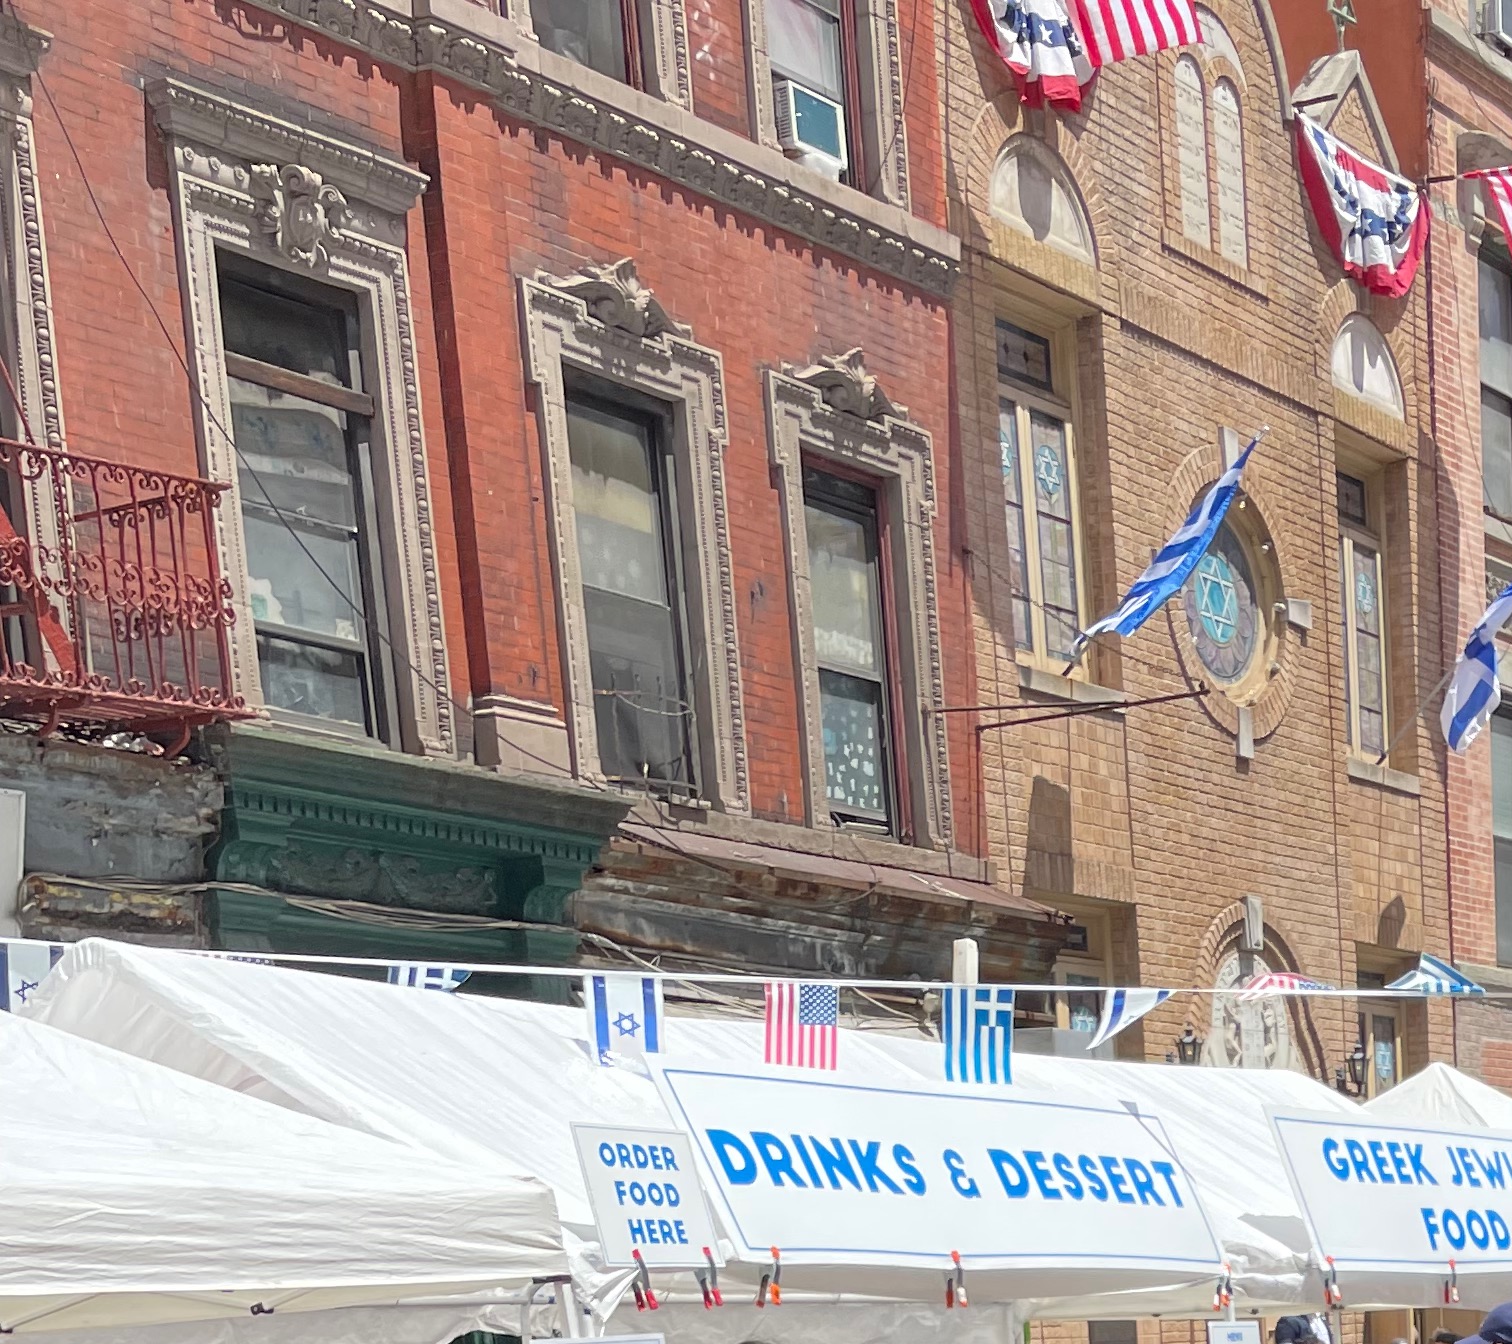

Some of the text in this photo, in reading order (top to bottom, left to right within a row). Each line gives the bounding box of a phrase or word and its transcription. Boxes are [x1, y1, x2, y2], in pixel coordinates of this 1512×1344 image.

[599, 1142, 680, 1172] ORDER
[705, 1129, 1186, 1208] DRINKS & DESSERT
[1322, 1138, 1439, 1186] GREEK
[617, 1181, 681, 1208] FOOD
[628, 1218, 689, 1245] HERE
[1421, 1208, 1511, 1251] FOOD
